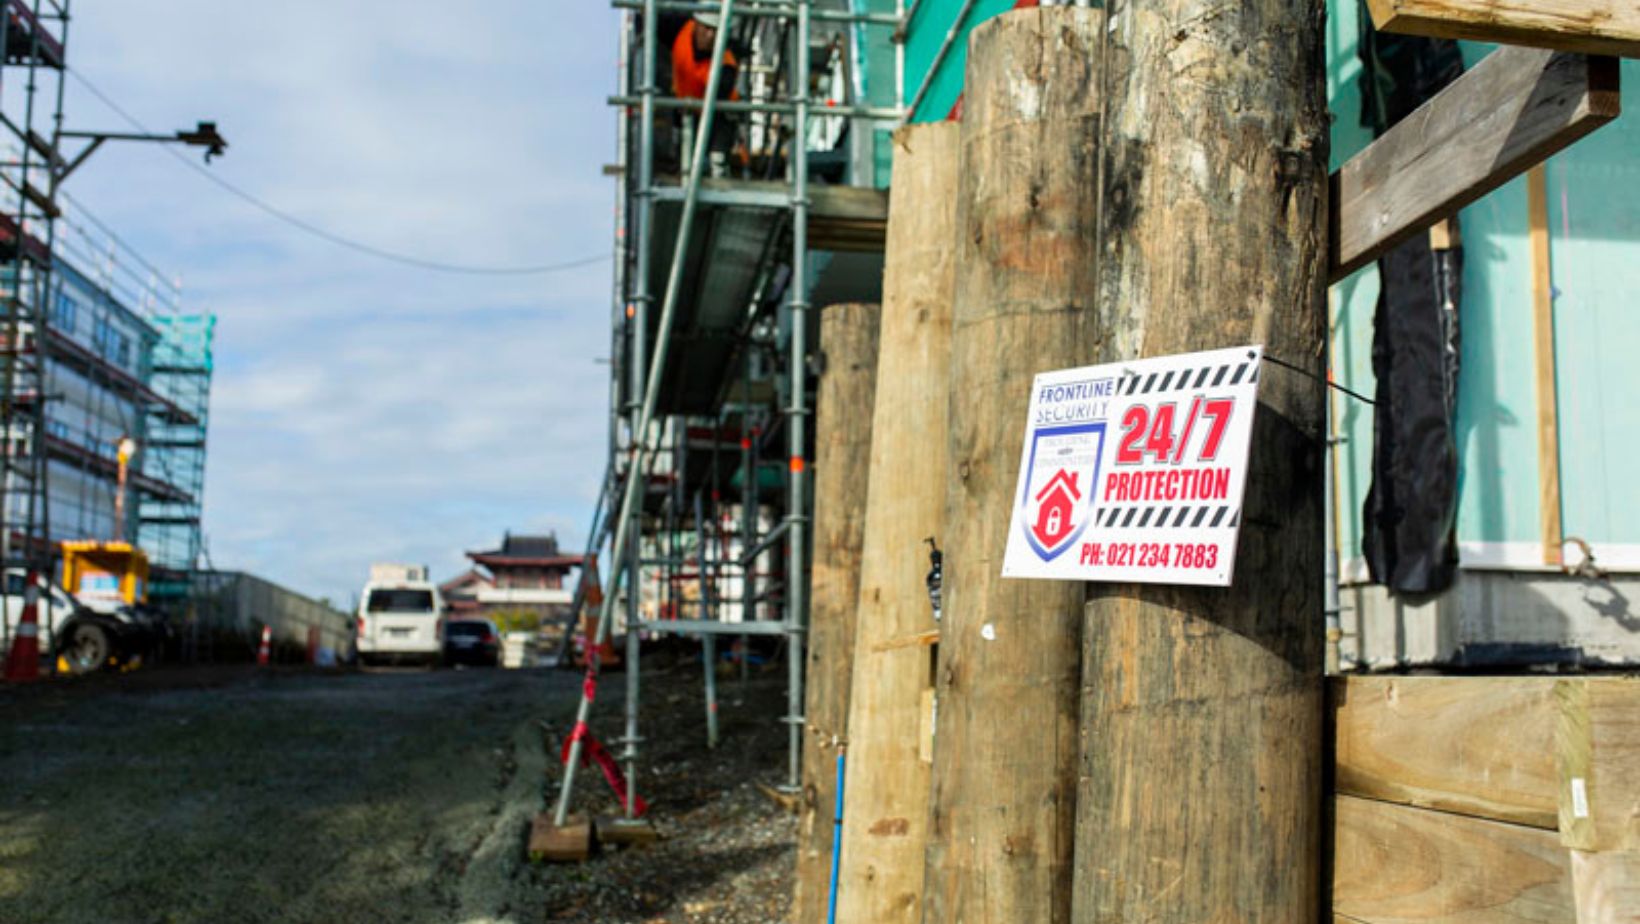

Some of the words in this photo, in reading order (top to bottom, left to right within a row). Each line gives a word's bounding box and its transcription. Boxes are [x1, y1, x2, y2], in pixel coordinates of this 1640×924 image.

[1039, 381, 1114, 404] FRONTLINE
[1036, 401, 1108, 422] SECURITY
[1115, 395, 1236, 466] 24/7
[1105, 468, 1231, 502] PROTECTION
[1080, 542, 1104, 566] PH:
[1106, 542, 1136, 566] 021
[1137, 543, 1171, 568] 234
[1174, 543, 1218, 569] 7883
